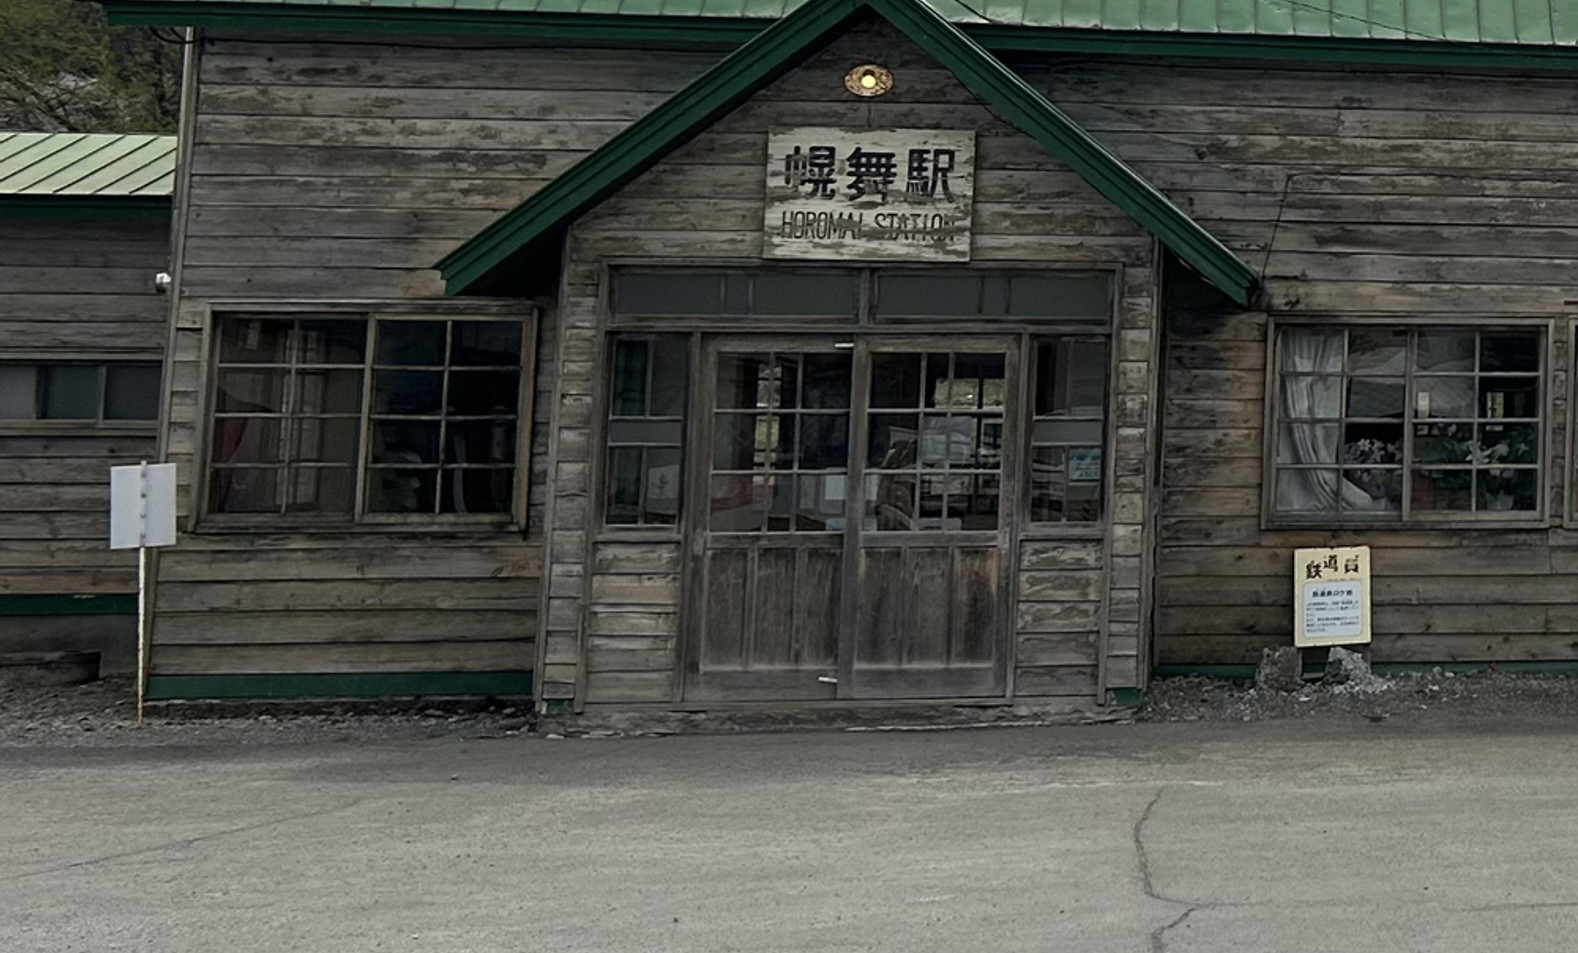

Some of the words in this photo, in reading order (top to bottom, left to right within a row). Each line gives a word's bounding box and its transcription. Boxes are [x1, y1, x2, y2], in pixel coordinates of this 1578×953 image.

[784, 145, 957, 203] 幌舞駅
[781, 210, 864, 240] HOROMAI
